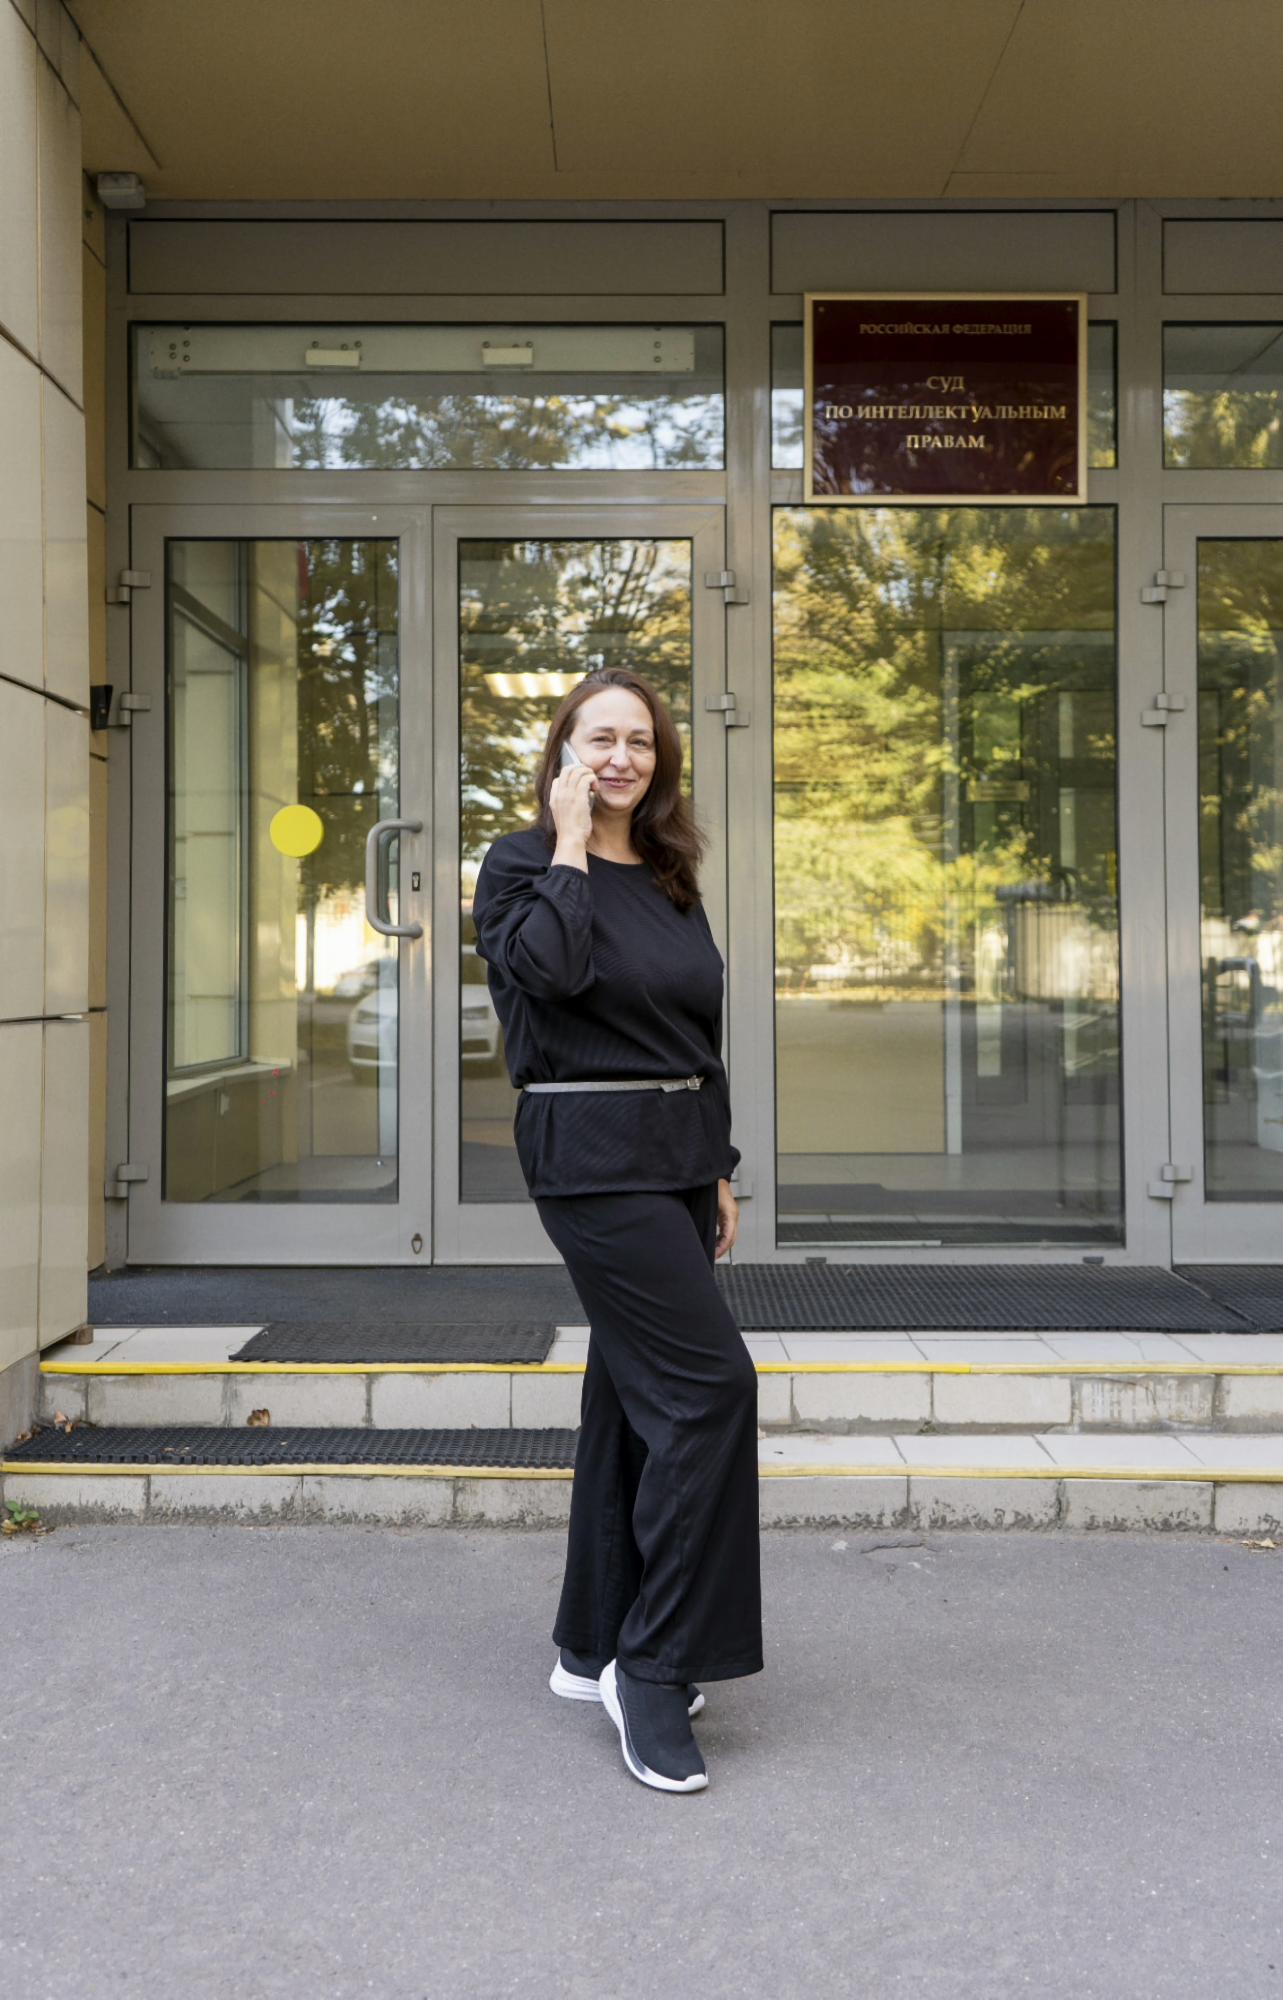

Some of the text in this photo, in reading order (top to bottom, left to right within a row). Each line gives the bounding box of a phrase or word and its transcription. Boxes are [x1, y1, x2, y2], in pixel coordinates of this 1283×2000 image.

[859, 322, 1032, 335] РОССИЙСКАЯ ФЕДЕРАЦИЯ
[926, 375, 965, 393] СУД
[825, 405, 1067, 422] ПО ИНТЕЛЛЕКТУАЛЬНЫМ
[906, 434, 985, 449] ПРАВАМ
